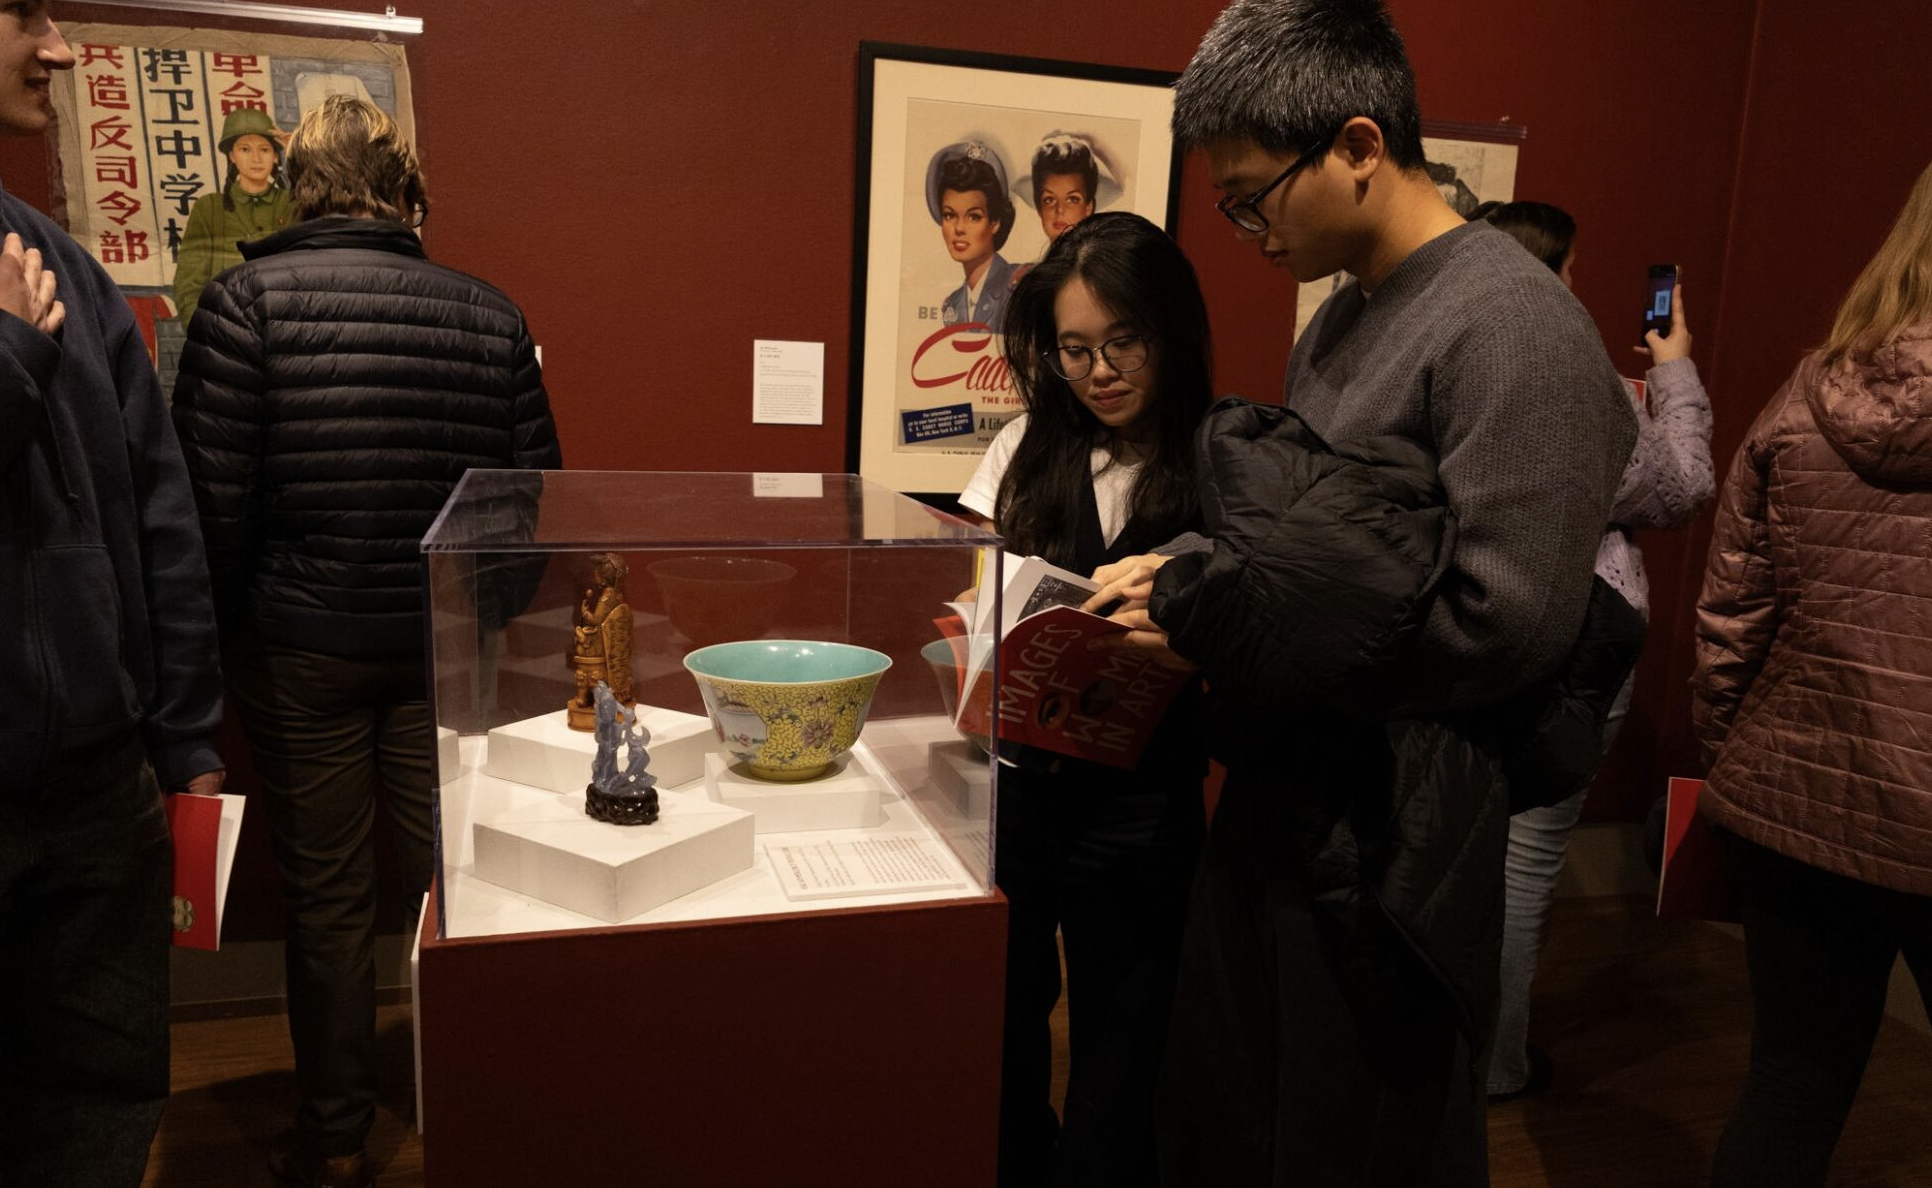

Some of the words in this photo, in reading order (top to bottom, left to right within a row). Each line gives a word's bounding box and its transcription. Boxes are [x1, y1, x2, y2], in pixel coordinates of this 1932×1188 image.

[918, 306, 938, 320] BE
[943, 306, 958, 322] A
[911, 322, 1014, 394] Cade
[981, 396, 1000, 405] THE
[1003, 397, 1022, 405] GIR
[979, 417, 986, 431] A
[989, 417, 1011, 430] Life
[998, 623, 1083, 723] IMAGES
[1097, 721, 1136, 752] IN
[1118, 662, 1172, 719] ART
